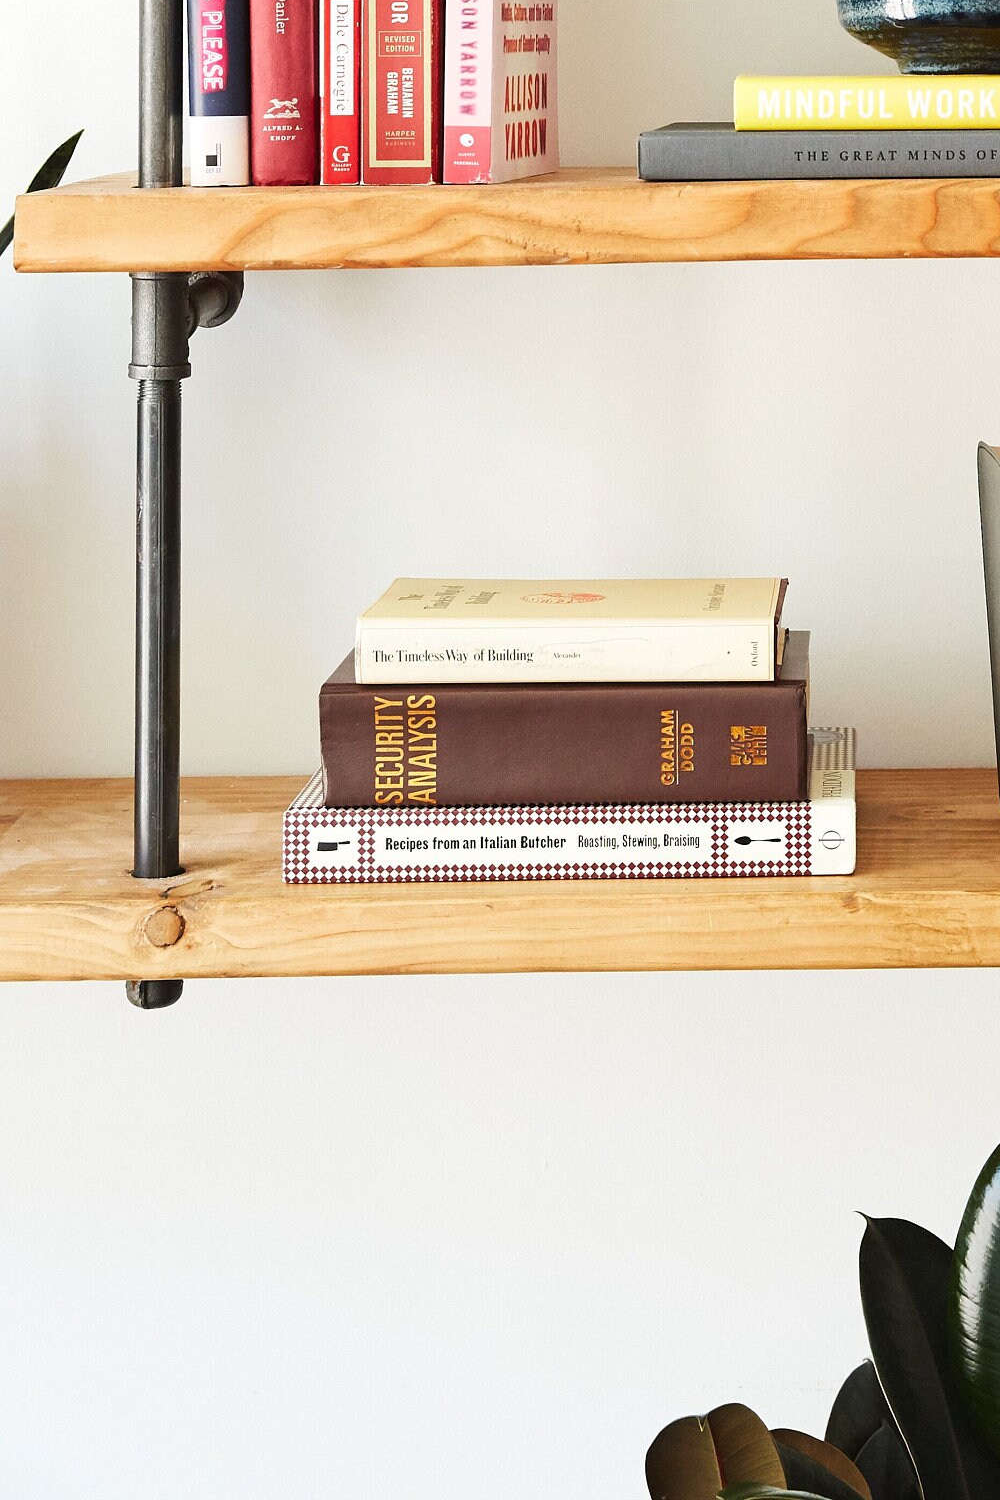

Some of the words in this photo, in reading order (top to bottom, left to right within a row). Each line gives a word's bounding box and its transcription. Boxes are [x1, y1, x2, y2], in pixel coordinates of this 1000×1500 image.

[201, 11, 225, 91] PLEASE
[758, 88, 892, 121] MINDFUL
[904, 89, 999, 121] WORK
[795, 151, 828, 161] THE
[840, 151, 897, 161] GREAT
[909, 150, 965, 160] MINDS
[977, 150, 997, 160] OF
[374, 696, 404, 803] SECURITY
[407, 695, 436, 803] ANALYSIS
[661, 710, 674, 785] GRAHAM
[681, 723, 695, 771] DODD
[386, 837, 428, 852] Recipes
[433, 837, 459, 849] from
[463, 840, 476, 849] an
[481, 836, 516, 848] Italian
[521, 836, 566, 848] Butcher
[579, 835, 619, 849] Roasting,
[623, 835, 660, 849] Stewing,
[664, 834, 699, 848] Braising
